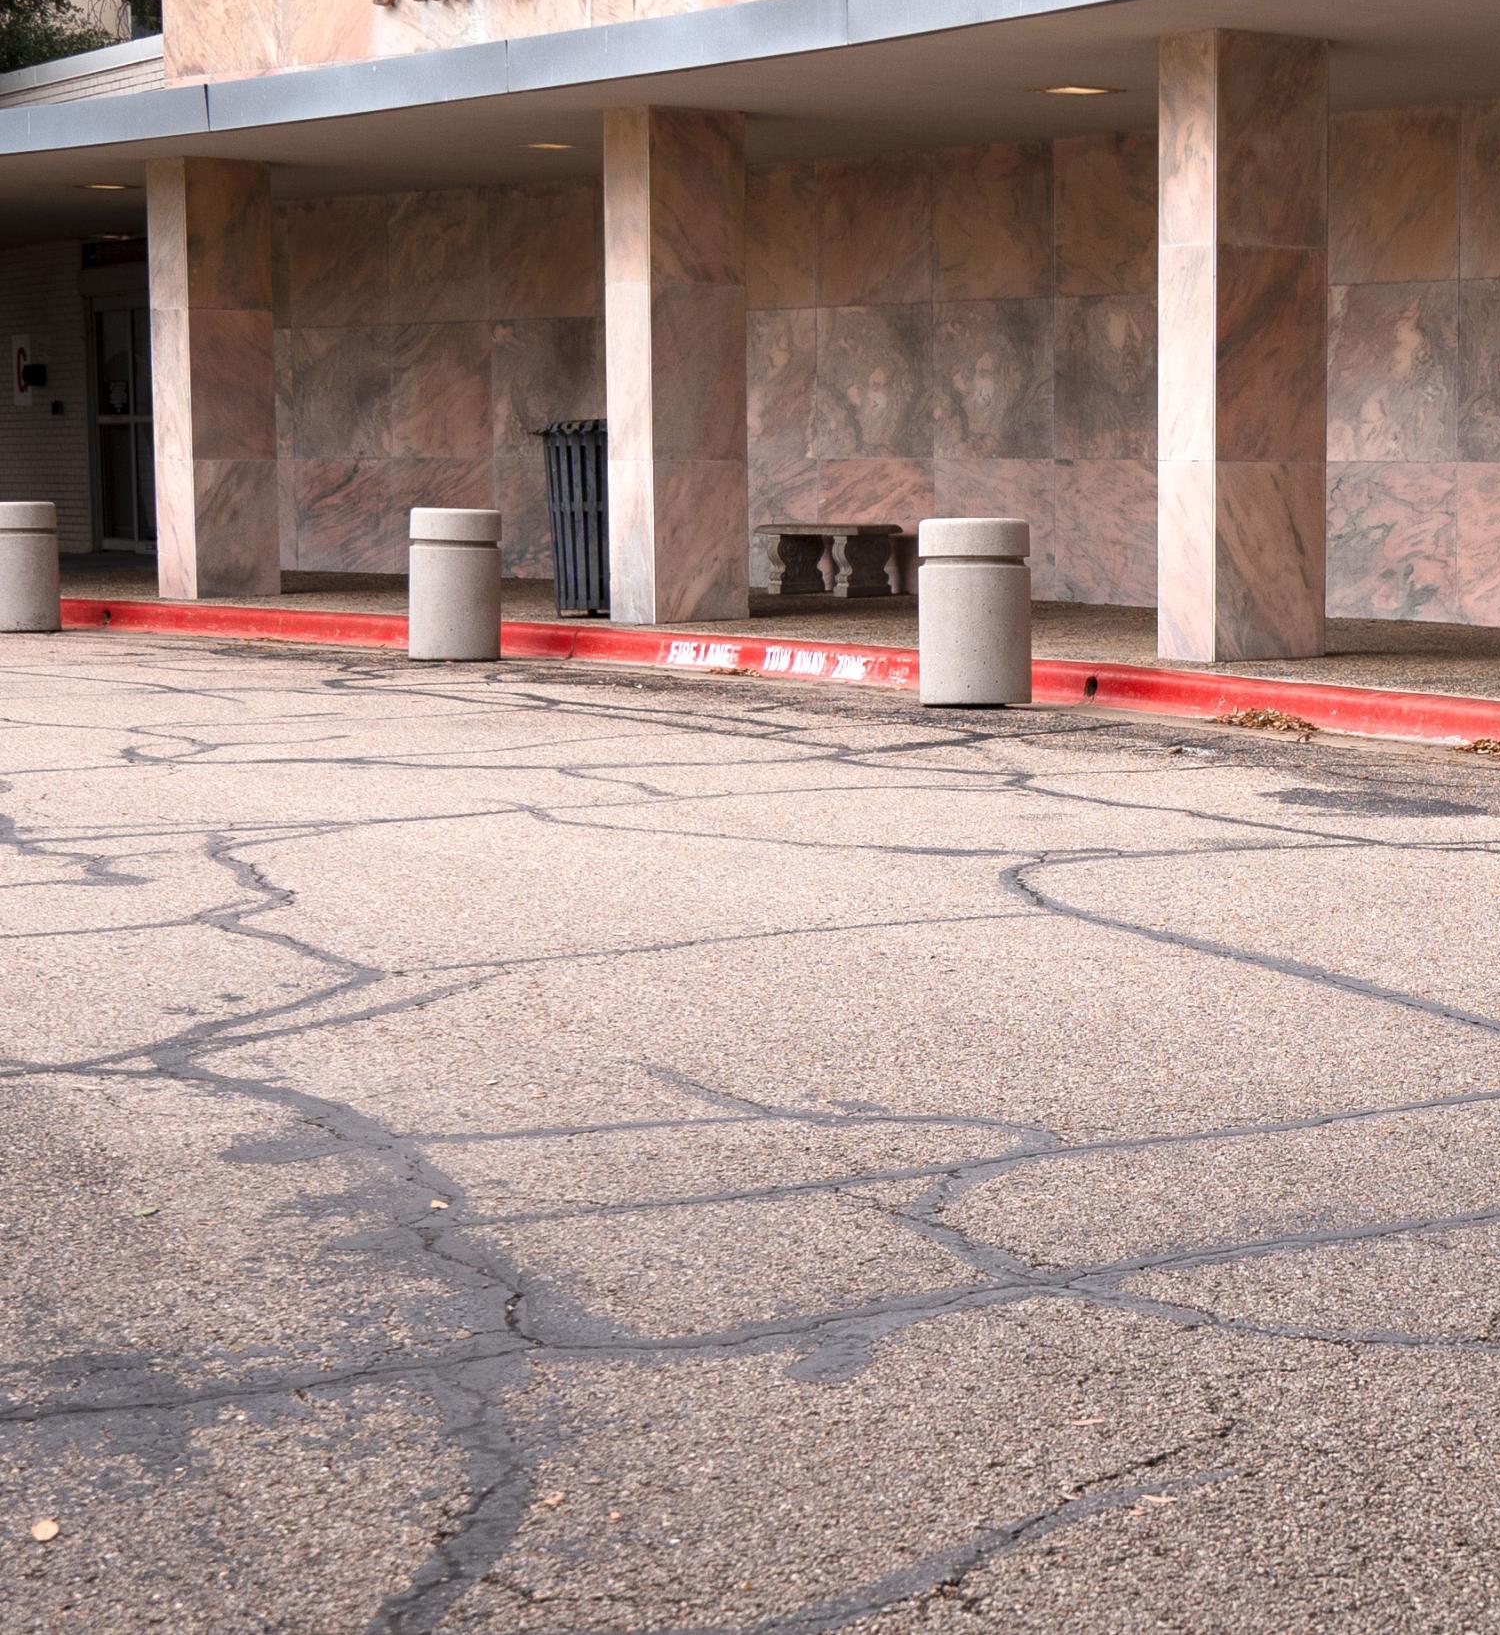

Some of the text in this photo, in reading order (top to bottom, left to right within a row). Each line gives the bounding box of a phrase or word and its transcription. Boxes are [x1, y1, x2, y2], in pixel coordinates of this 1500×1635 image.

[667, 641, 699, 665] FIRE
[696, 643, 737, 668] LANE
[762, 646, 791, 671] TOW
[790, 649, 826, 675] AWAY
[831, 653, 868, 680] ZONE
